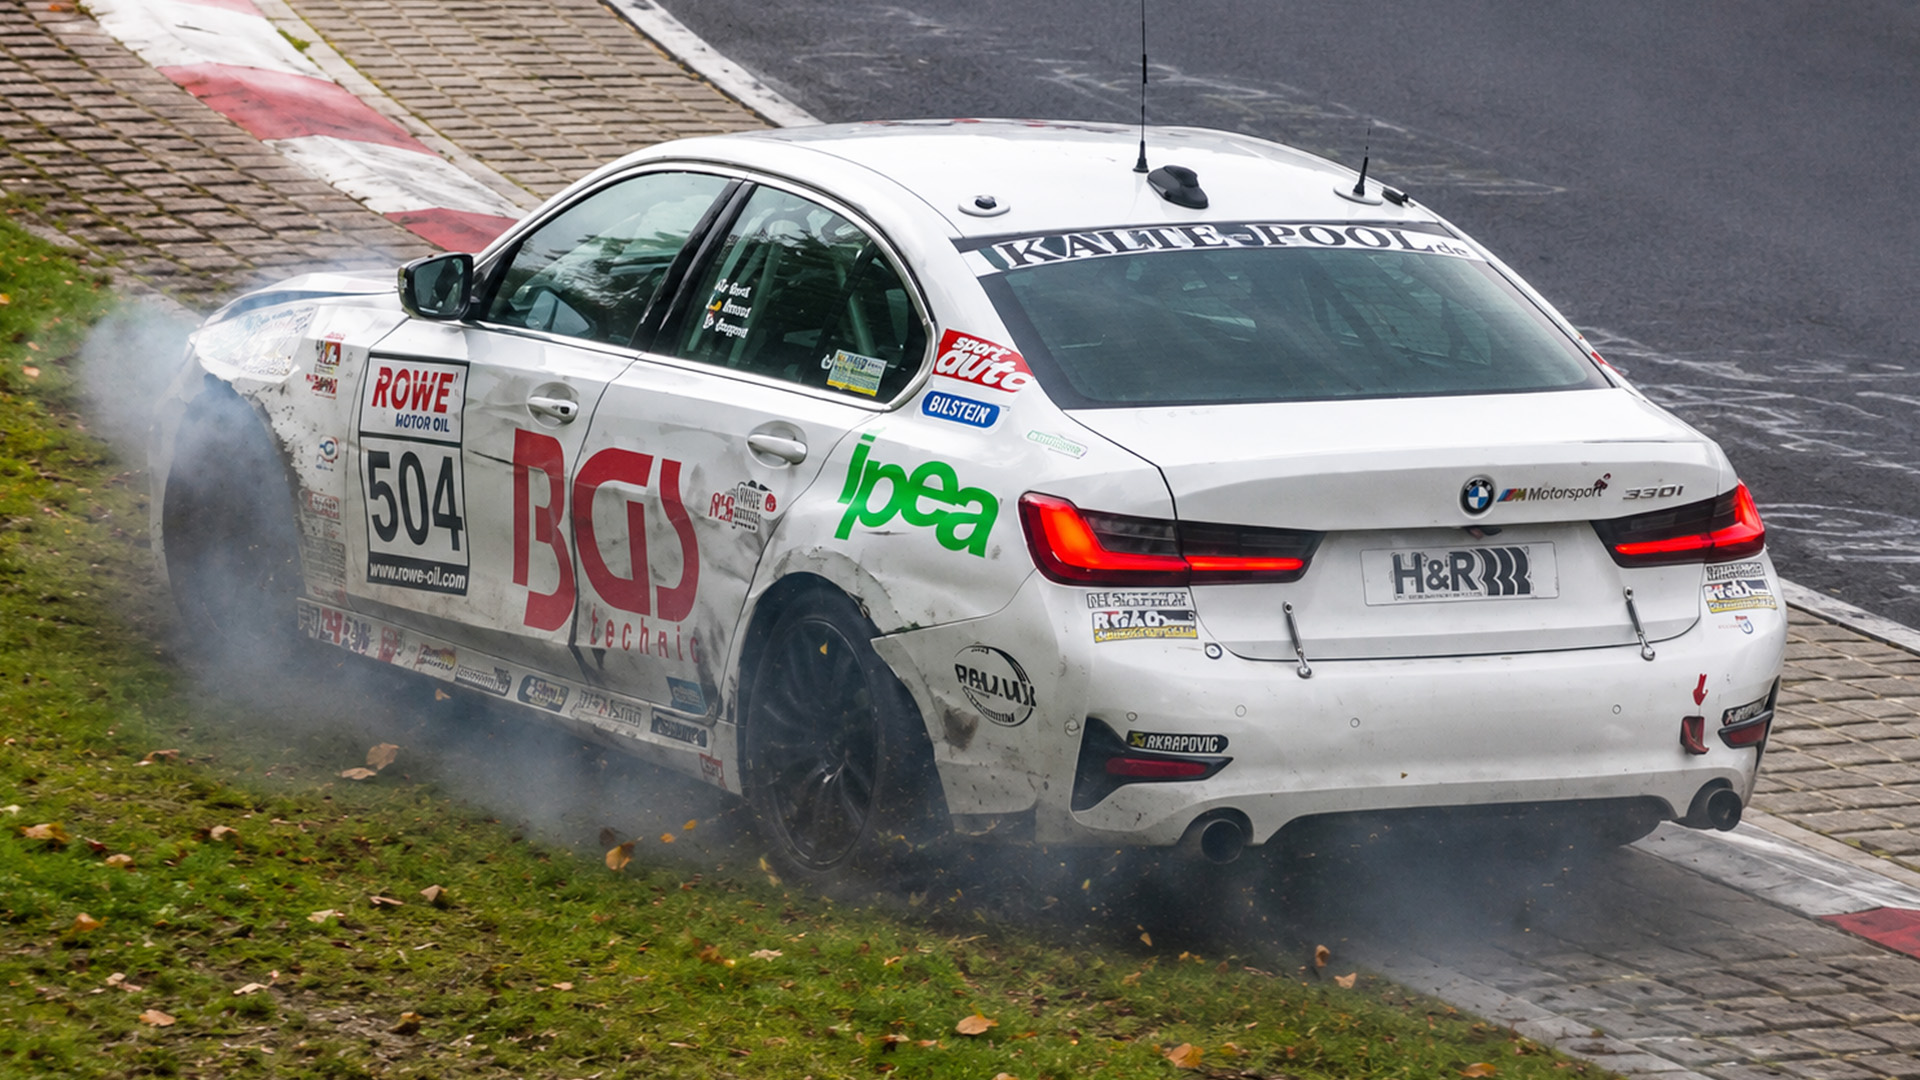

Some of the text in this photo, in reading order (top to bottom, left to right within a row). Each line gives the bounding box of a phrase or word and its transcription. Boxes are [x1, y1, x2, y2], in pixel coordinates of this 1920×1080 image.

[952, 336, 1011, 361] sport
[936, 350, 1034, 391] auto
[372, 366, 454, 414] ROWE
[395, 413, 450, 433] MOTOR OIL
[929, 395, 991, 424] BILSTEIN
[368, 449, 463, 551] 504
[1528, 486, 1602, 501] Motorsport
[370, 562, 466, 589] www.rowe-oil.com
[1392, 551, 1479, 595] H&R
[590, 604, 699, 663] technic
[1146, 735, 1219, 752] AKRAPOVIC
